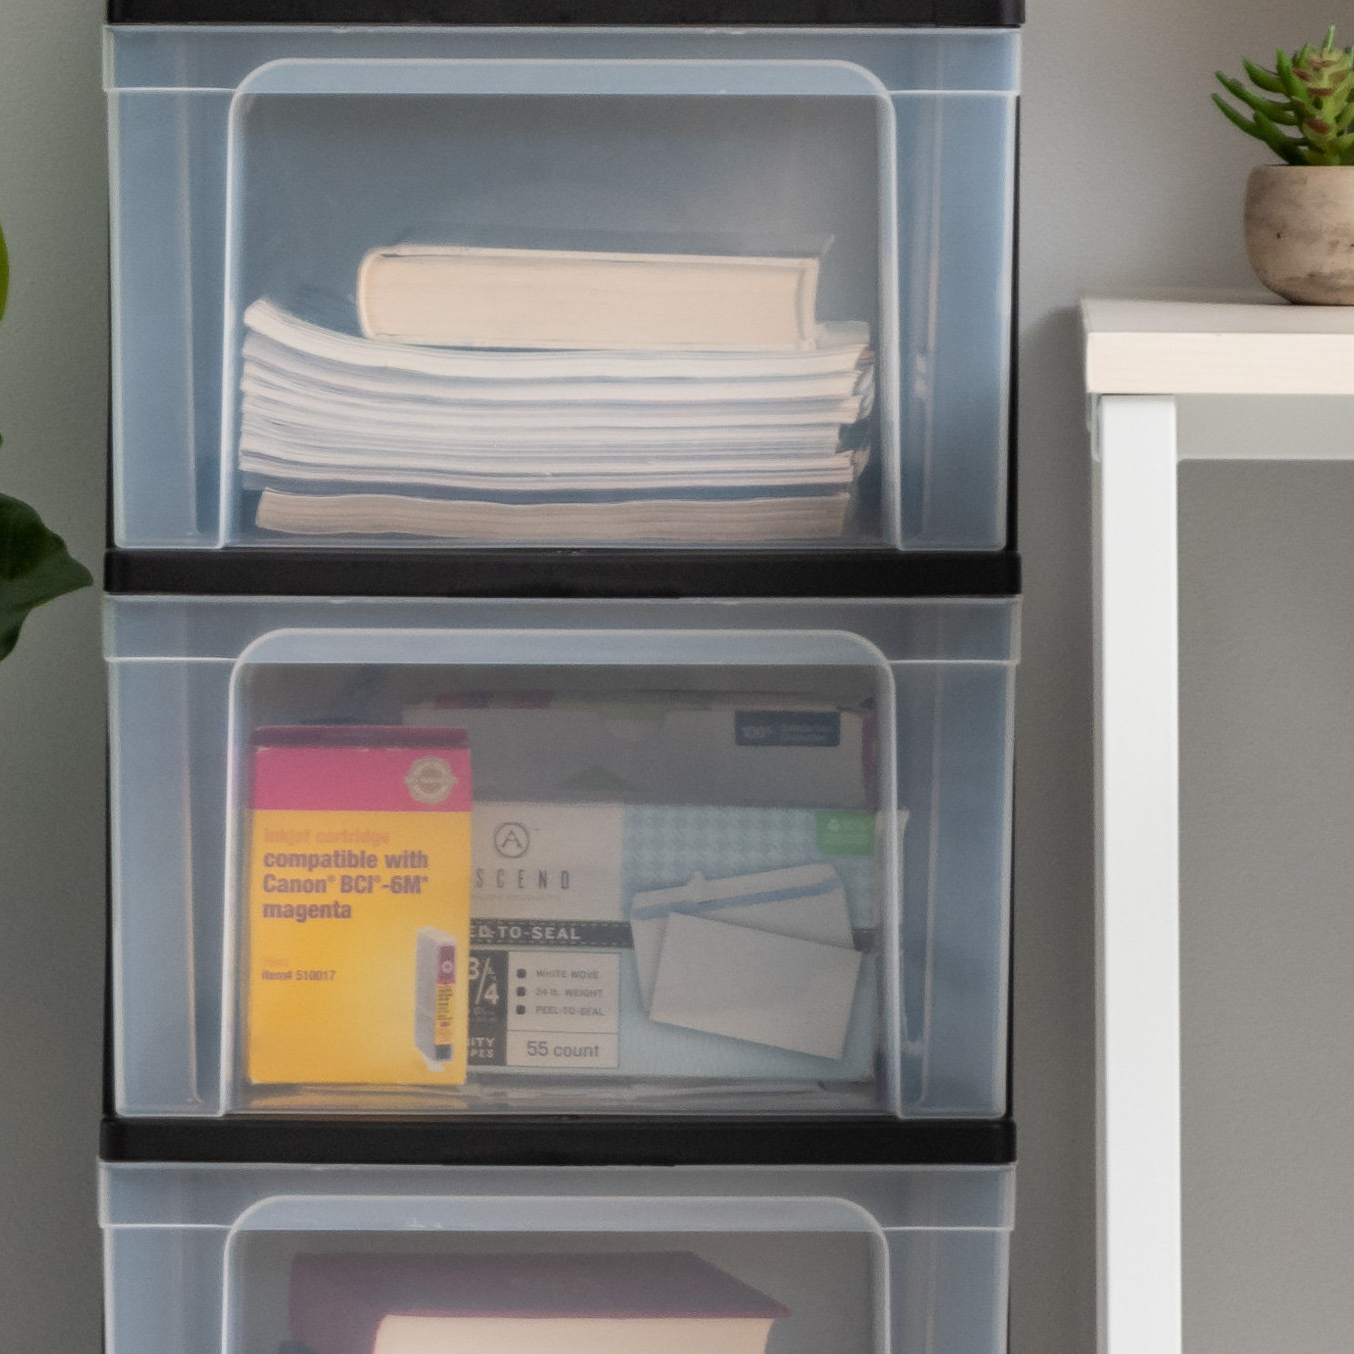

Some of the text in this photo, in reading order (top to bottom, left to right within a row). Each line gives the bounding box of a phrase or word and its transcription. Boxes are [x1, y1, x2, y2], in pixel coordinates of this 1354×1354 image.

[263, 829, 390, 846] inkjet cartridge
[263, 849, 429, 872] compatible with
[475, 868, 570, 890] SCEND
[262, 900, 352, 923] magenta
[536, 969, 567, 979] WHITE
[565, 989, 603, 998] WEIGHT
[527, 1040, 599, 1058] 55 count
